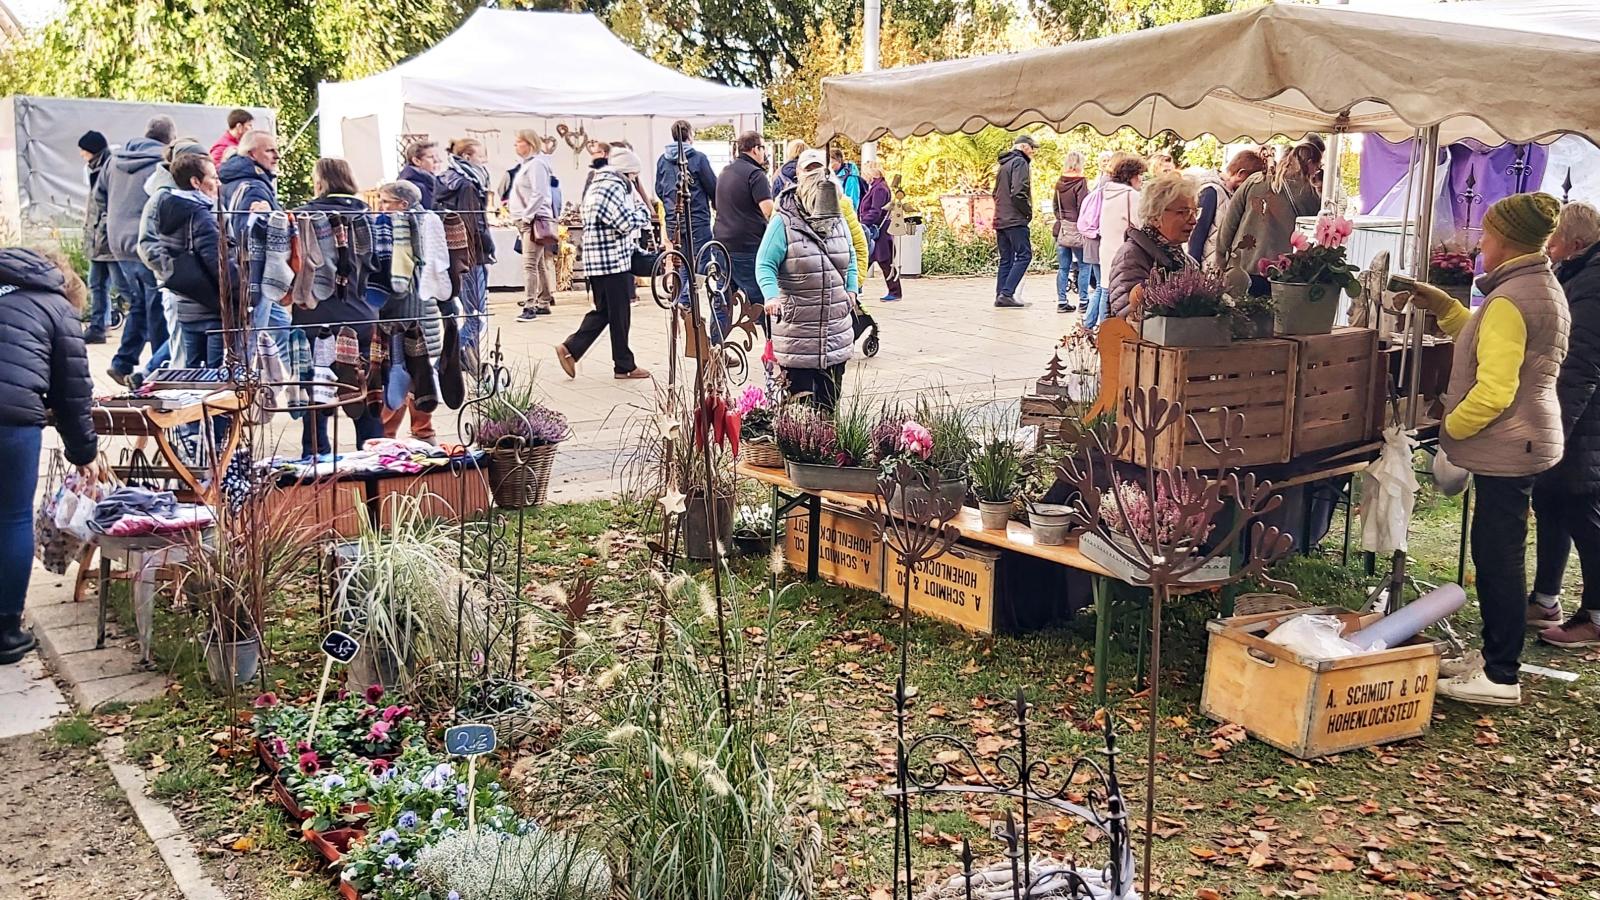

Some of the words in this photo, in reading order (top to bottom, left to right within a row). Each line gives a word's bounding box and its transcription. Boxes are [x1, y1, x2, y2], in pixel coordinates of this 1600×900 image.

[794, 535, 805, 552] CO.
[820, 545, 858, 570] SCHMIDT
[861, 558, 870, 574] A.
[913, 575, 919, 590] &
[924, 579, 965, 606] SCHMIDT
[972, 594, 981, 612] A.
[1326, 689, 1337, 709] A.
[1346, 680, 1394, 706] SCHMIDT
[1400, 679, 1407, 697] &
[1414, 674, 1429, 694] CO.
[1327, 699, 1421, 735] HOHENLOCKSTEDT
